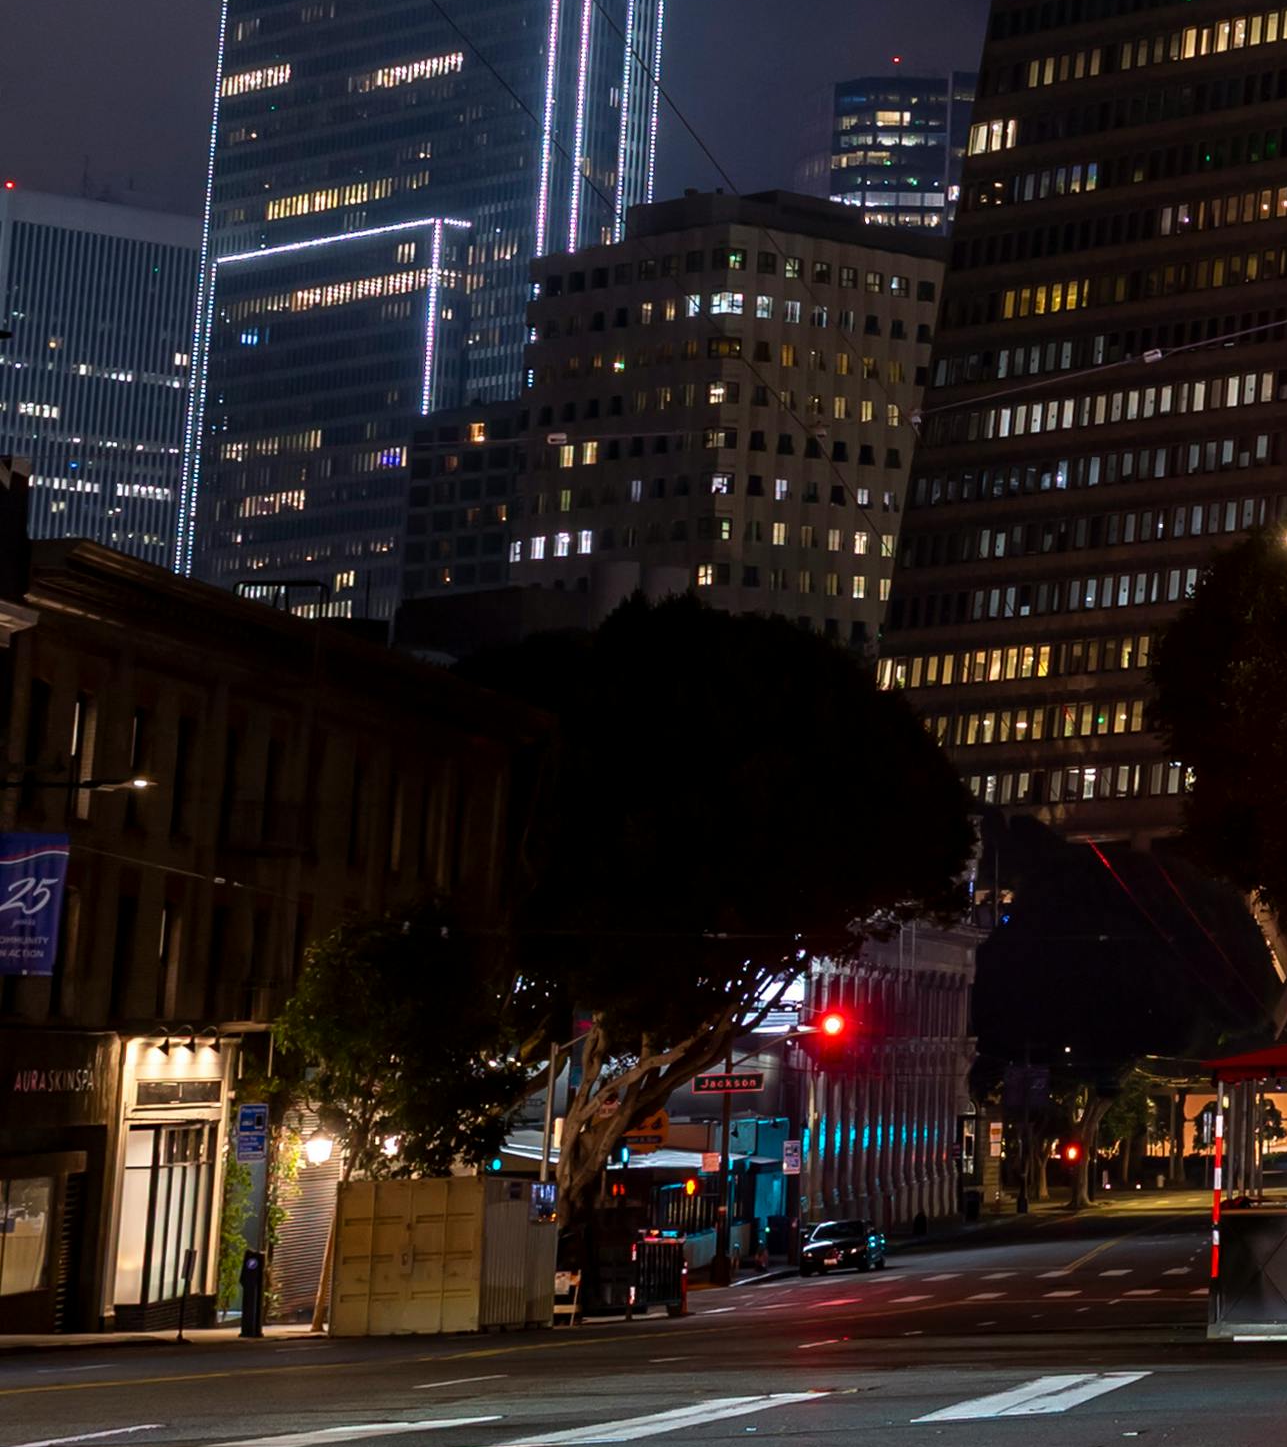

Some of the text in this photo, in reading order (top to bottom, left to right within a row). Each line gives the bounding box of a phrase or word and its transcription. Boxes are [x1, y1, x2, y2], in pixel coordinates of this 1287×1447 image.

[0, 877, 59, 914] 25
[0, 936, 49, 945] OMMUNITY
[701, 1078, 756, 1089] Jackson
